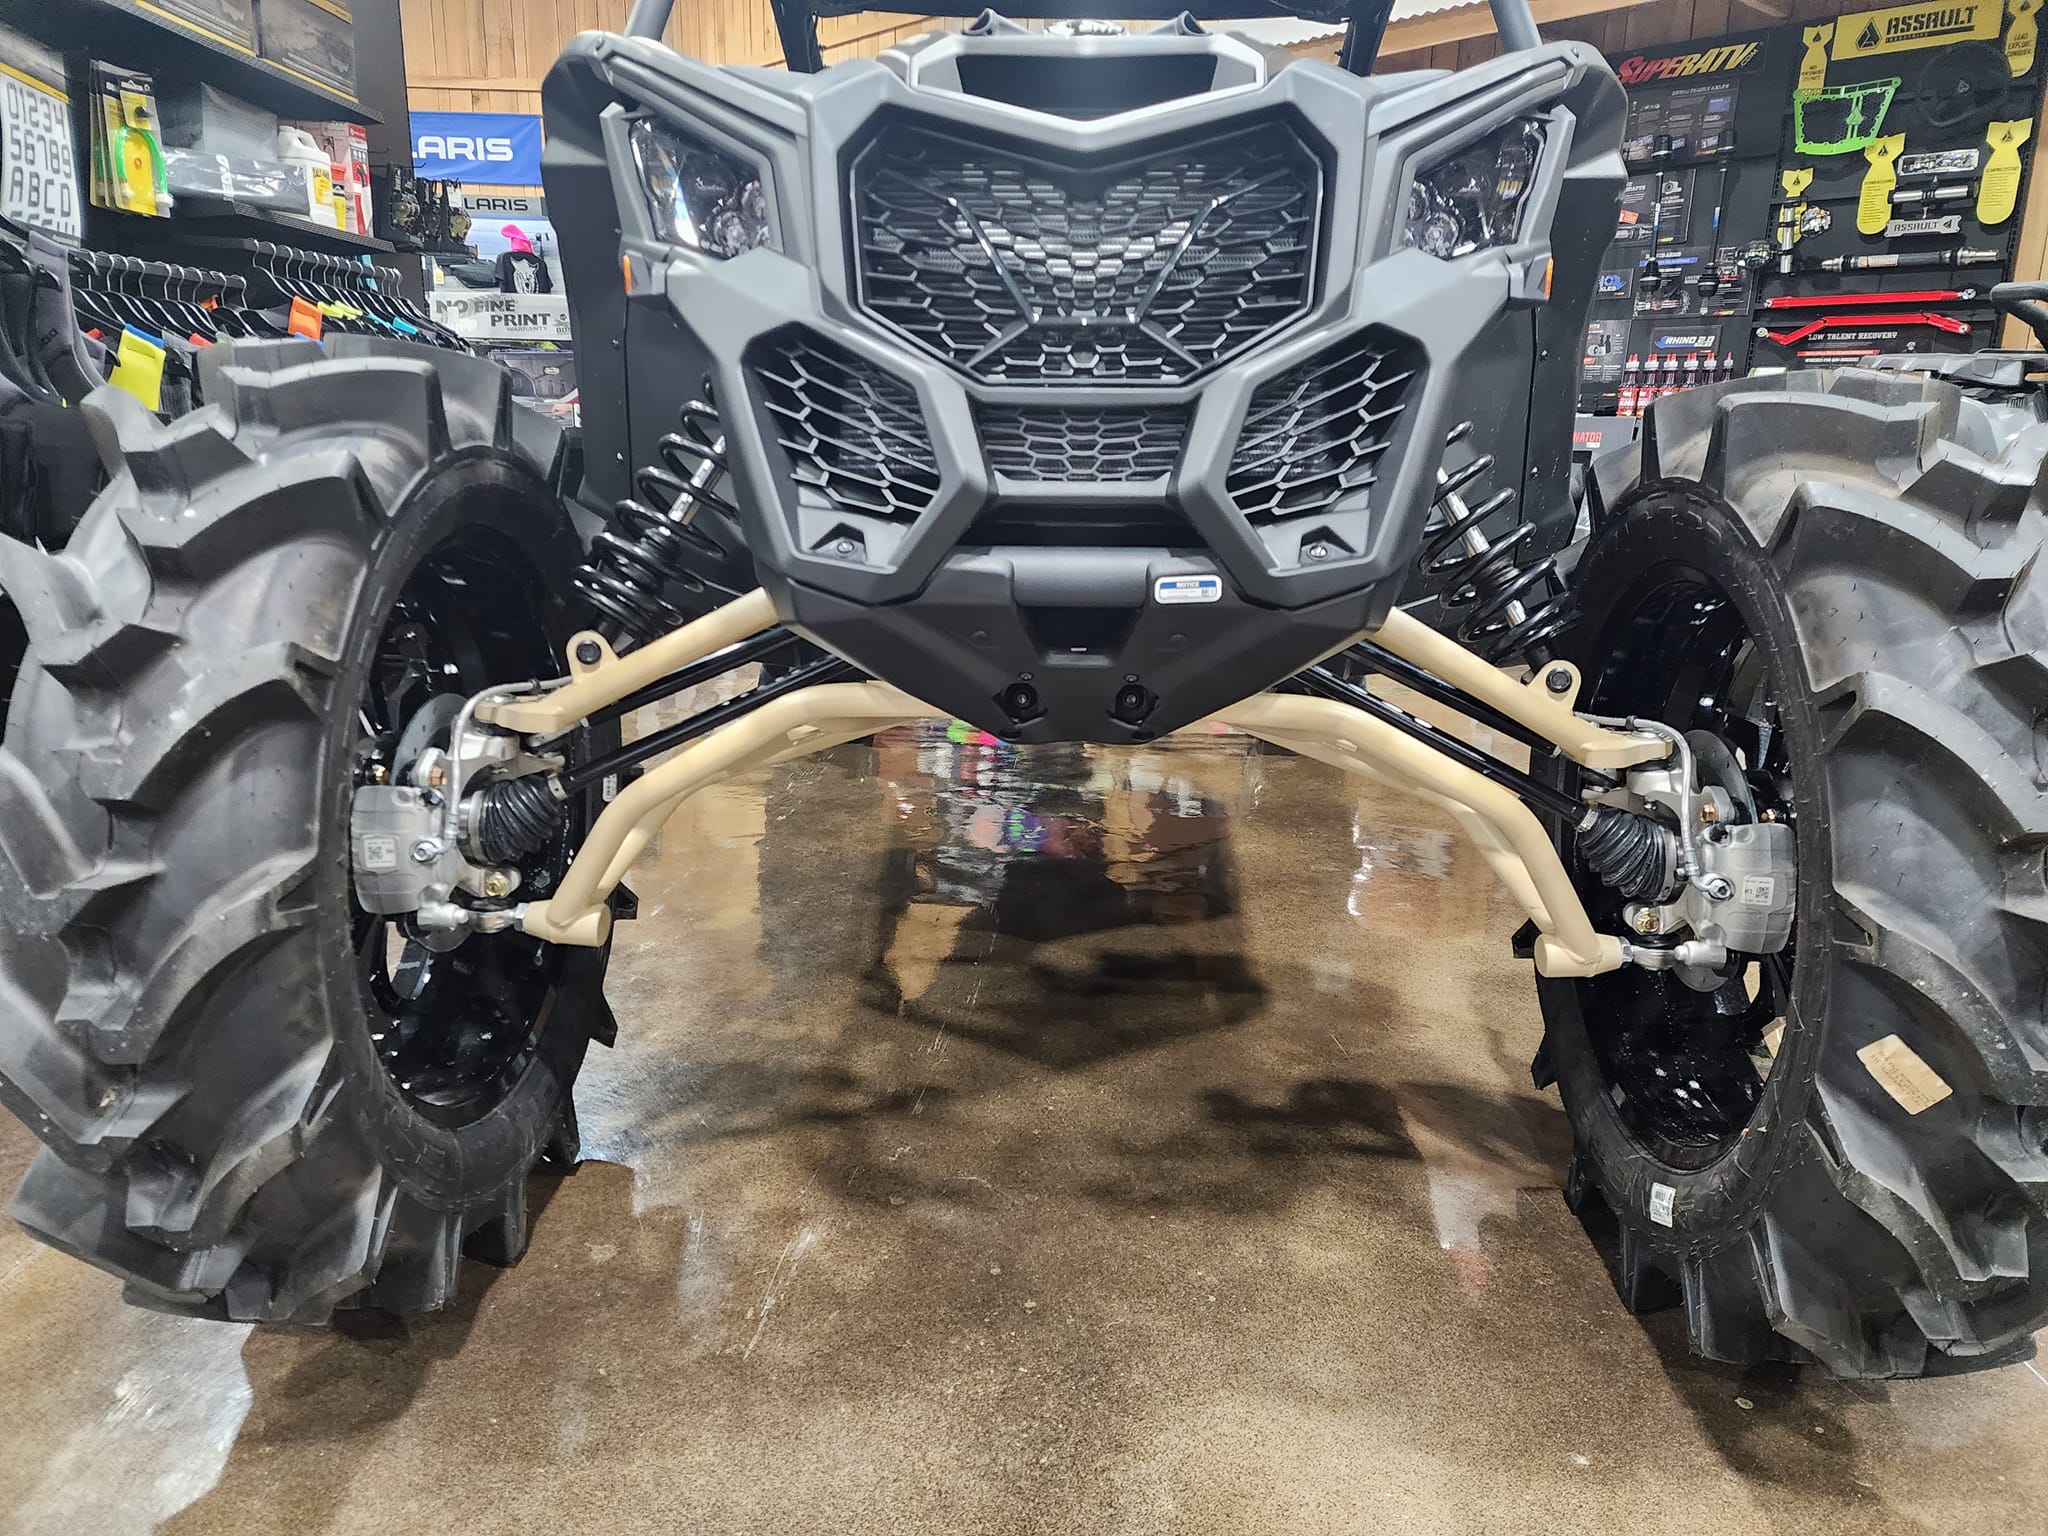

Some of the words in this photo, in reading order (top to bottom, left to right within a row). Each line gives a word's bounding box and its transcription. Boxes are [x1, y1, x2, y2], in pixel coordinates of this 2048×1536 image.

[1887, 6, 1978, 35] ASSAULT
[1893, 220, 1940, 233] ASSAULT
[490, 313, 551, 327] PRINT
[1664, 336, 1697, 345] RHINO
[1808, 333, 1824, 341] LOW
[1827, 333, 1856, 341] TALENT
[1858, 331, 1899, 340] RECOVERY
